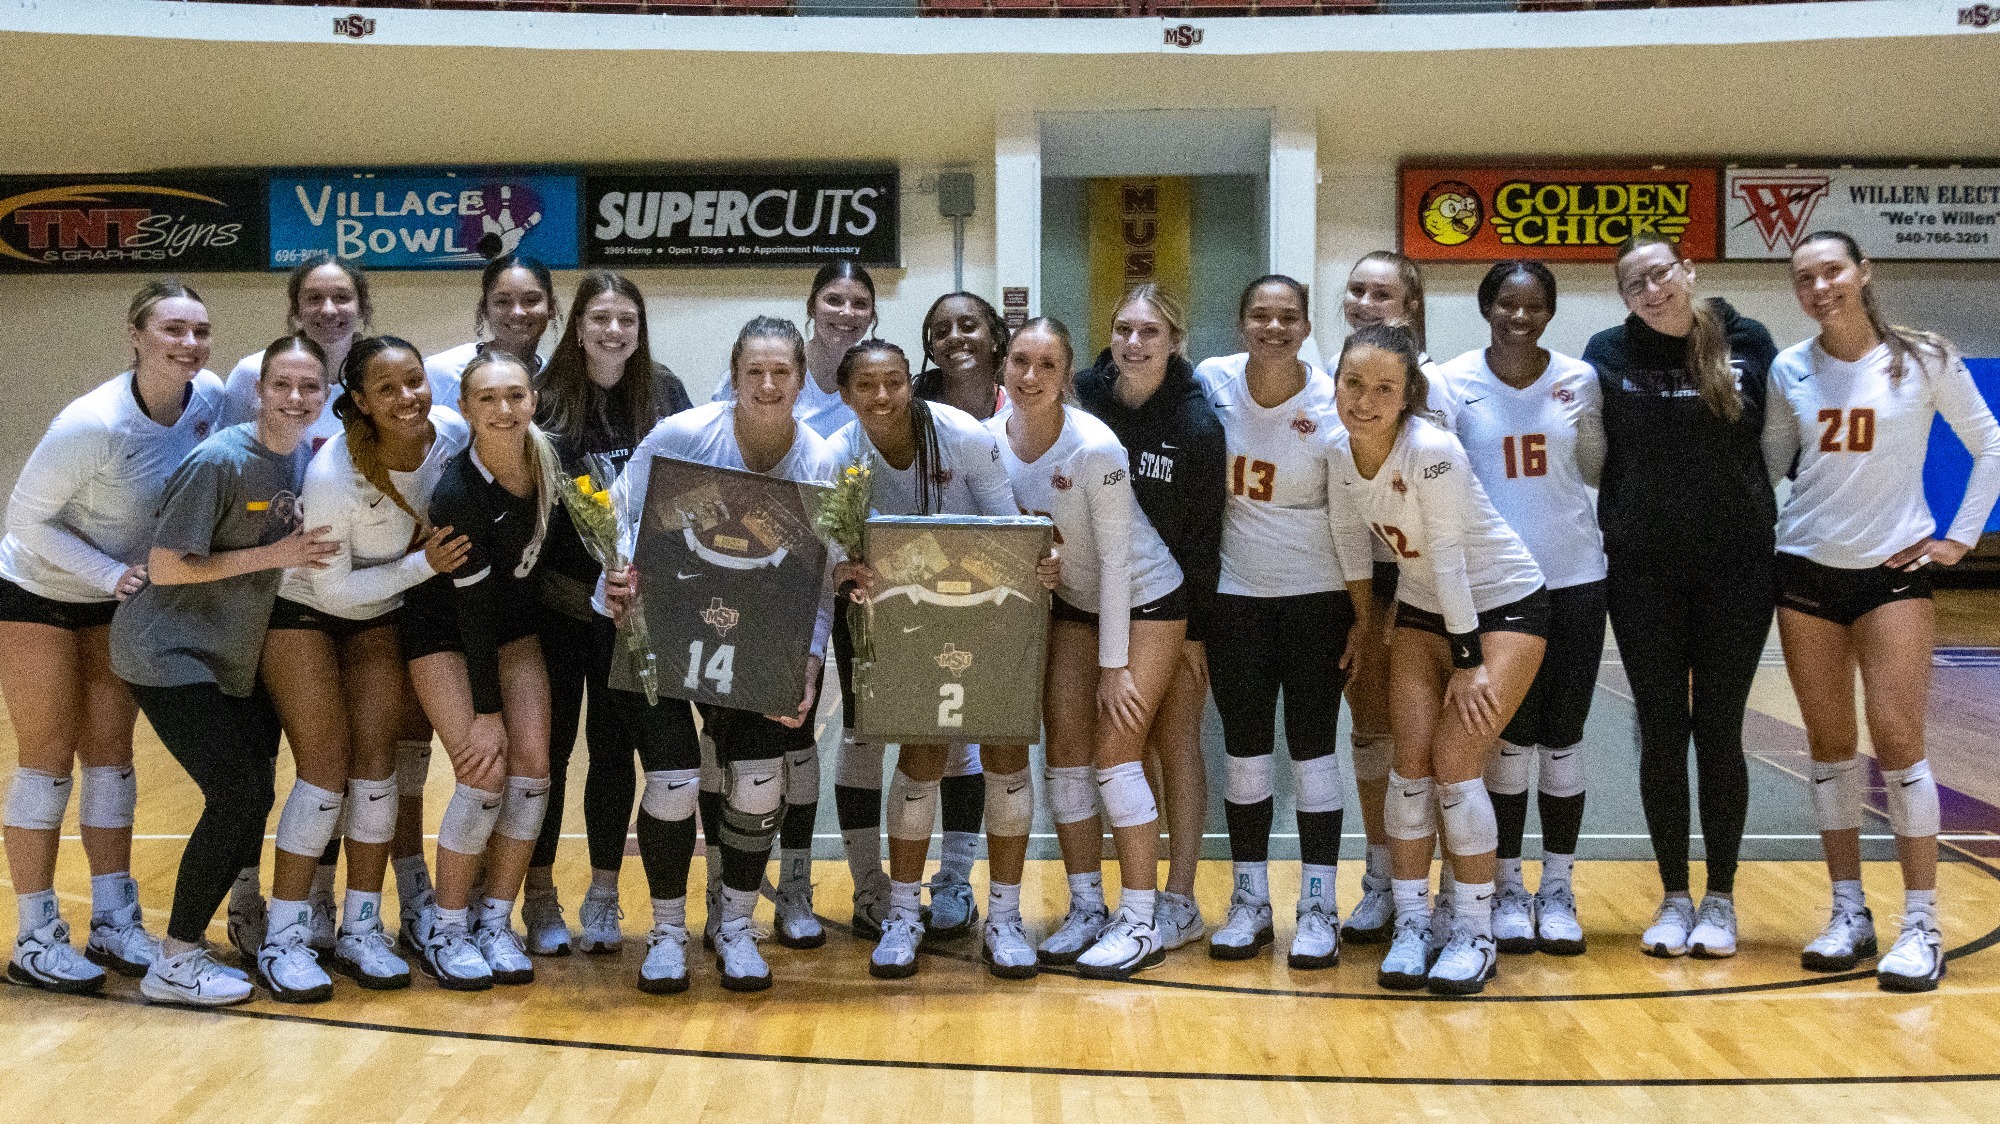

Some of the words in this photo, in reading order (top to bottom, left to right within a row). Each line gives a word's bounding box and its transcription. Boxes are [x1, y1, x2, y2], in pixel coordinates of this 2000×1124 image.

[333, 14, 376, 39] MSU
[1163, 24, 1204, 48] MSU
[295, 185, 484, 226] VILLAGE
[595, 187, 878, 240] SUPERCUTS
[1496, 182, 1690, 219] GOLDEN
[1849, 186, 1929, 204] WILLEN
[15, 209, 150, 248] TNT
[125, 214, 242, 256] Signs
[336, 219, 468, 260] BOWL
[668, 246, 692, 256] Open
[694, 246, 700, 254] 7
[701, 246, 724, 256] Days
[738, 245, 751, 254] No
[753, 245, 811, 255] Appointment
[812, 245, 860, 255] Necessary
[1122, 185, 1158, 289] MUS
[1514, 215, 1660, 245] CHICK
[43, 250, 59, 261] &
[62, 250, 166, 261] GRAPHICS
[1818, 408, 1876, 452] 20
[1139, 451, 1173, 482] STATE
[1503, 433, 1548, 479] 16
[1233, 455, 1276, 502] 13
[1371, 522, 1420, 559] 12
[683, 640, 735, 694] 14
[937, 683, 965, 727] 2
